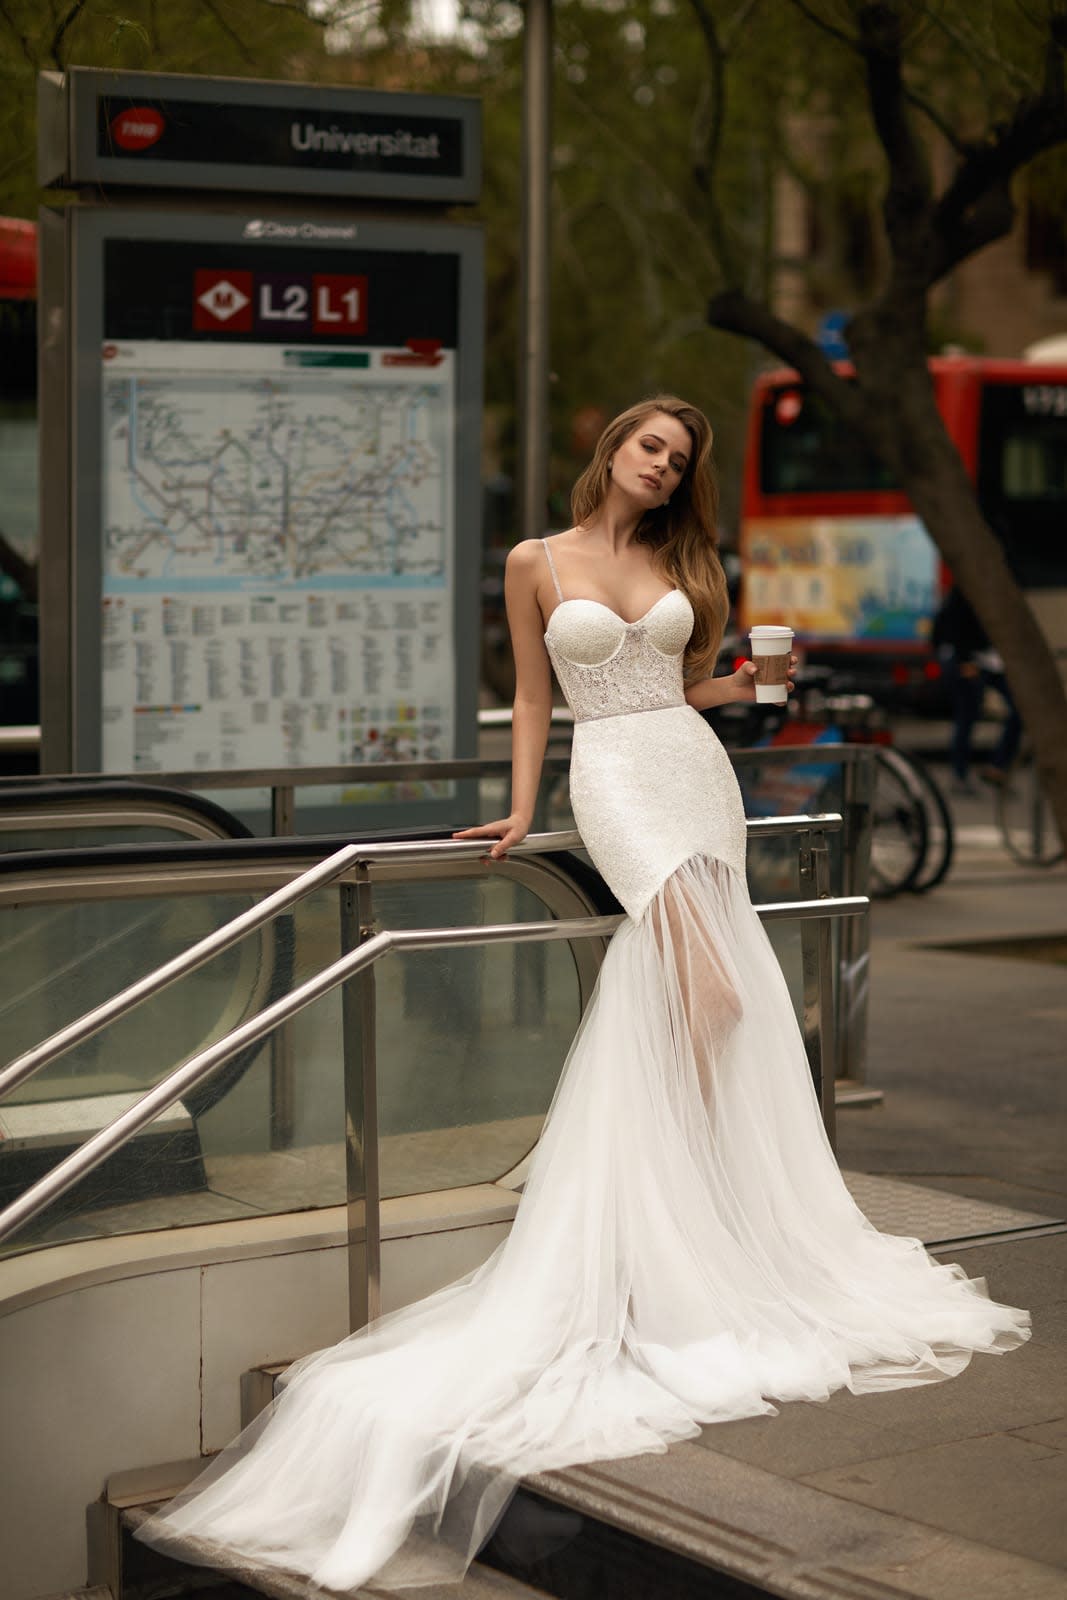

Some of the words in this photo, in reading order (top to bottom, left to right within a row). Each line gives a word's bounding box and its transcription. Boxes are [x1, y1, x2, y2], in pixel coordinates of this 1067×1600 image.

[291, 122, 440, 158] Universitat
[260, 284, 308, 320] L2
[318, 285, 360, 323] L1
